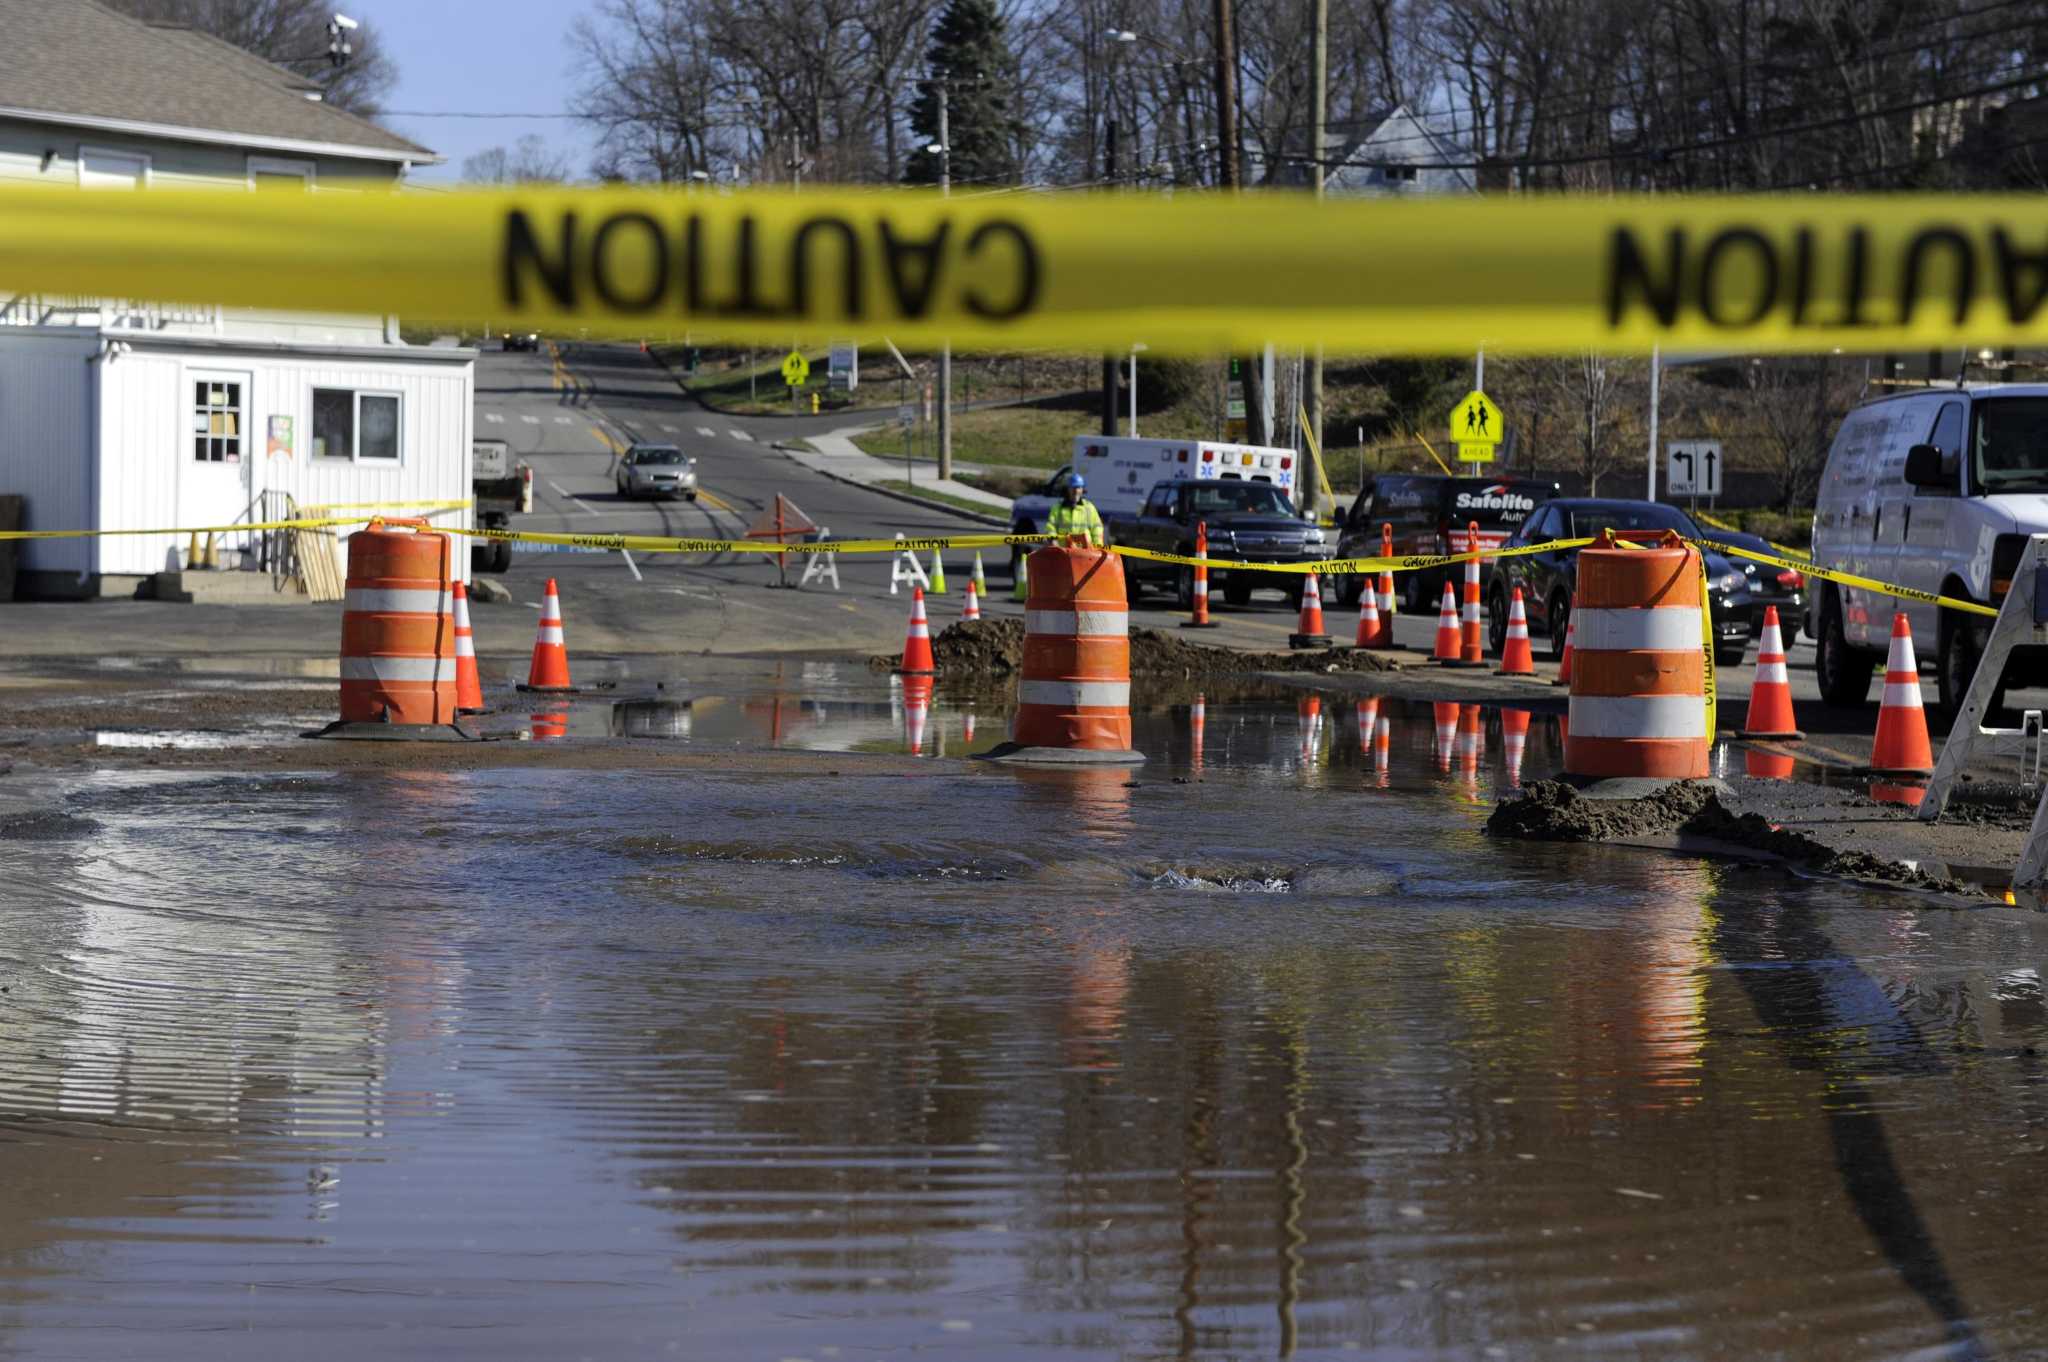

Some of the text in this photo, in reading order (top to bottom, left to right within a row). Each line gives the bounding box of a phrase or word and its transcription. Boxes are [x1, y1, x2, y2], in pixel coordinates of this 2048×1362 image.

[503, 208, 1042, 322] CAUTION
[1464, 447, 1490, 457] AHEAD
[1671, 482, 1696, 493] ONLY
[1456, 492, 1534, 511] Safelite
[895, 539, 950, 549] CAUTION
[1312, 560, 1358, 574] CAUTION
